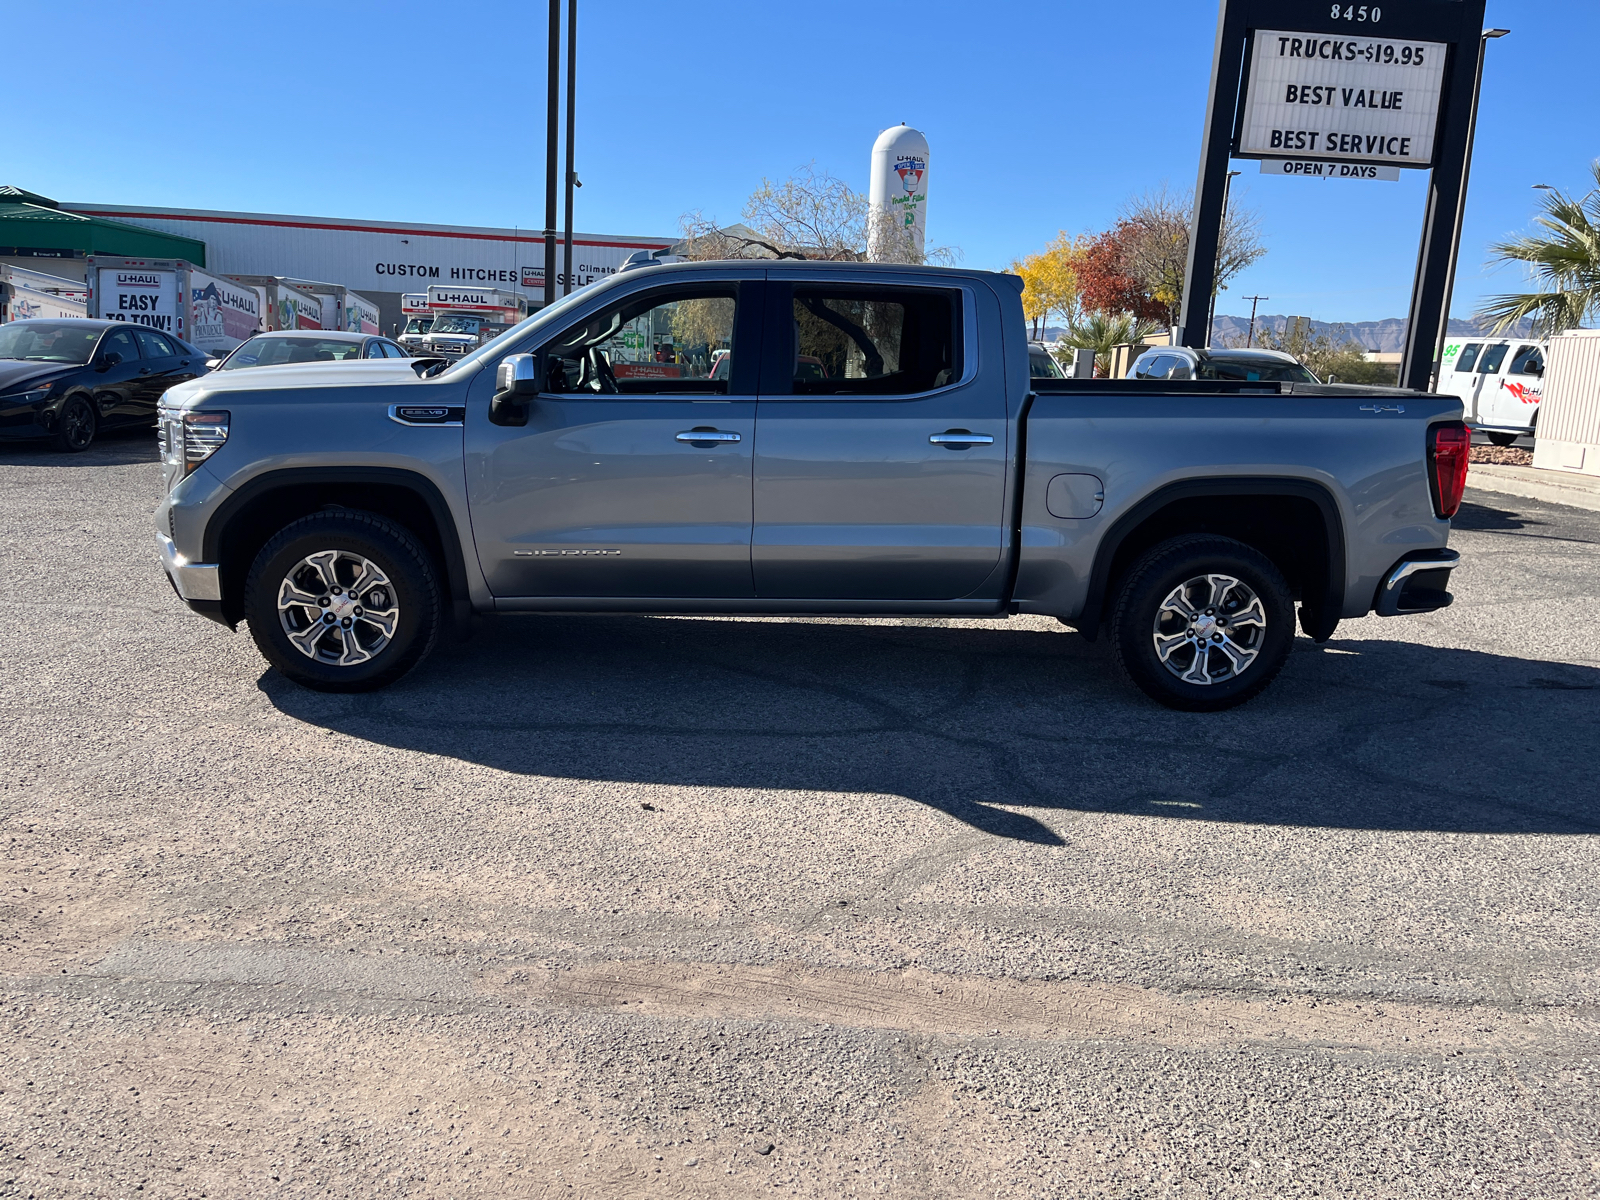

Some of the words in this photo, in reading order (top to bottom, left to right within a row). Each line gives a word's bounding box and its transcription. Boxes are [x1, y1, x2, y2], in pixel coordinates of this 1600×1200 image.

[1330, 4, 1382, 23] 8450
[1278, 37, 1424, 66] TRUCKS-$19.95
[1286, 84, 1336, 105] BEST
[1341, 88, 1403, 110] VALUE
[1270, 129, 1319, 150] BEST
[1326, 132, 1411, 156] SERVICE
[1283, 162, 1323, 175] OPEN
[1328, 164, 1335, 176] 7
[1340, 165, 1377, 178] DAYS
[375, 263, 440, 278] CUSTOM
[450, 267, 518, 282] HITCHES
[579, 264, 616, 274] Climate
[118, 274, 159, 284] U-HAUL
[119, 294, 159, 311] EASY
[222, 290, 256, 314] U-HAUL
[437, 293, 488, 304] U-HAUL
[1443, 344, 1461, 357] 95
[513, 548, 621, 557] SIERRA
[335, 600, 349, 614] GMC
[1199, 621, 1213, 635] GMC
